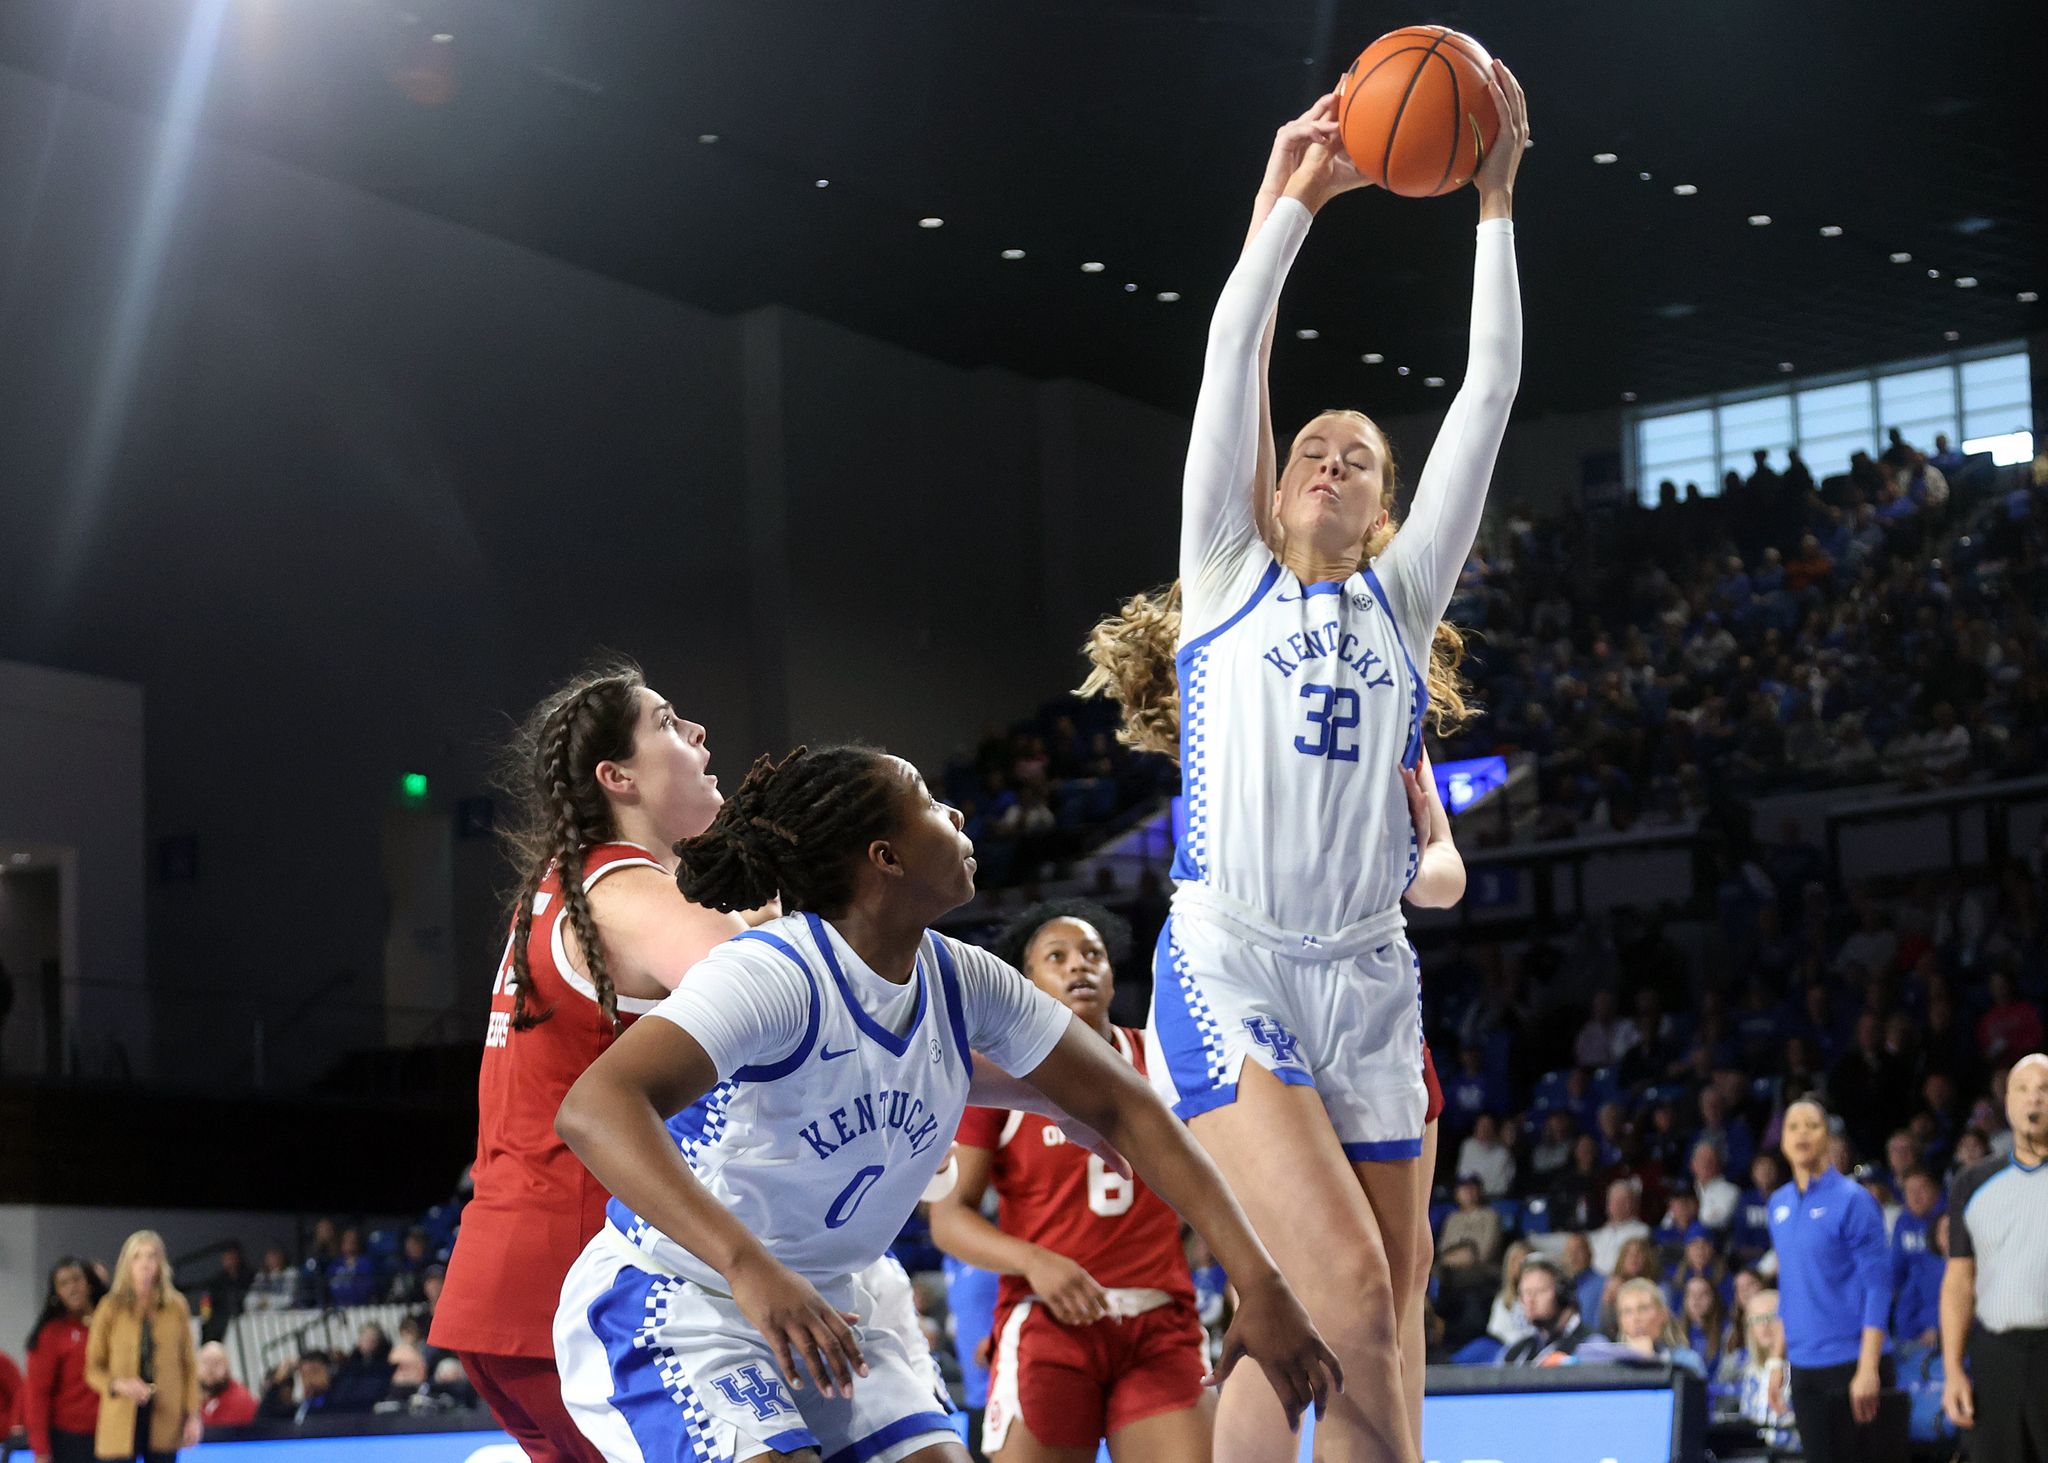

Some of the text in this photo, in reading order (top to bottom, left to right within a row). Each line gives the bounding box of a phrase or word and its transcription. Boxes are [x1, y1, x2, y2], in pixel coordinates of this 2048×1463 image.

[1263, 620, 1395, 689] KENTCKY
[1294, 682, 1361, 763] 32
[1241, 1015, 1305, 1065] UK
[798, 1089, 939, 1160] KENTUCKY
[824, 1164, 886, 1229] 0
[1087, 1152, 1135, 1217] 6
[709, 1363, 799, 1422] UK
